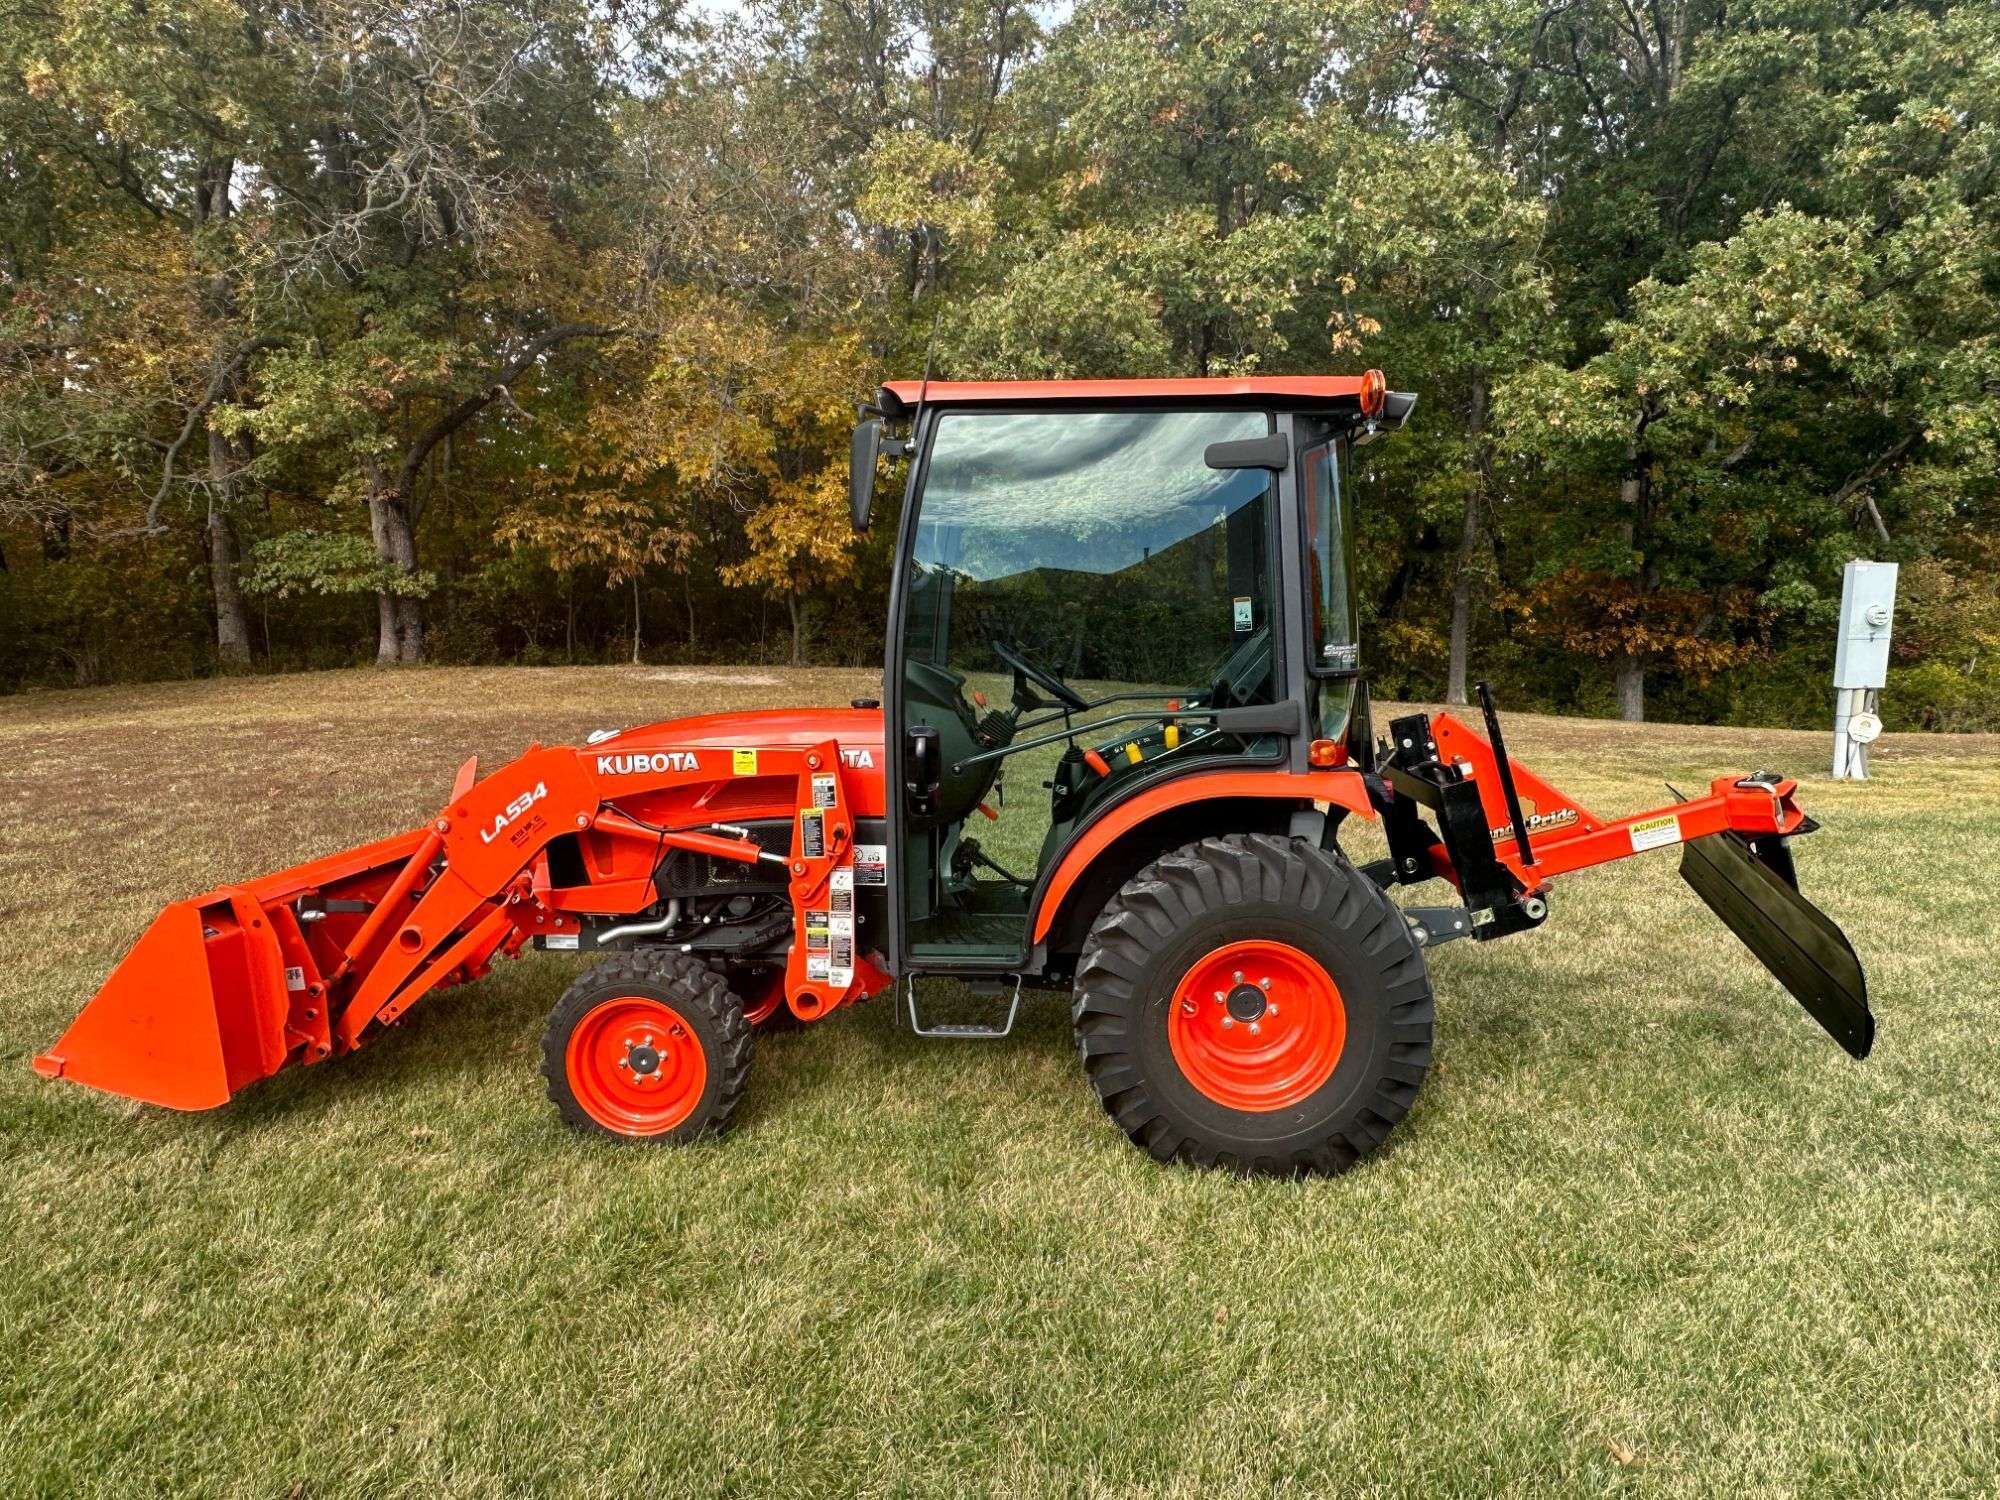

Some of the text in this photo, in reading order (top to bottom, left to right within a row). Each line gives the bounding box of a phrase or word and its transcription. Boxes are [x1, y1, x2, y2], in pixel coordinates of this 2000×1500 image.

[597, 752, 700, 776] KUBOTA
[480, 781, 548, 844] LA534
[1528, 808, 1577, 828] Pride
[1639, 816, 1675, 831] CAUTION
